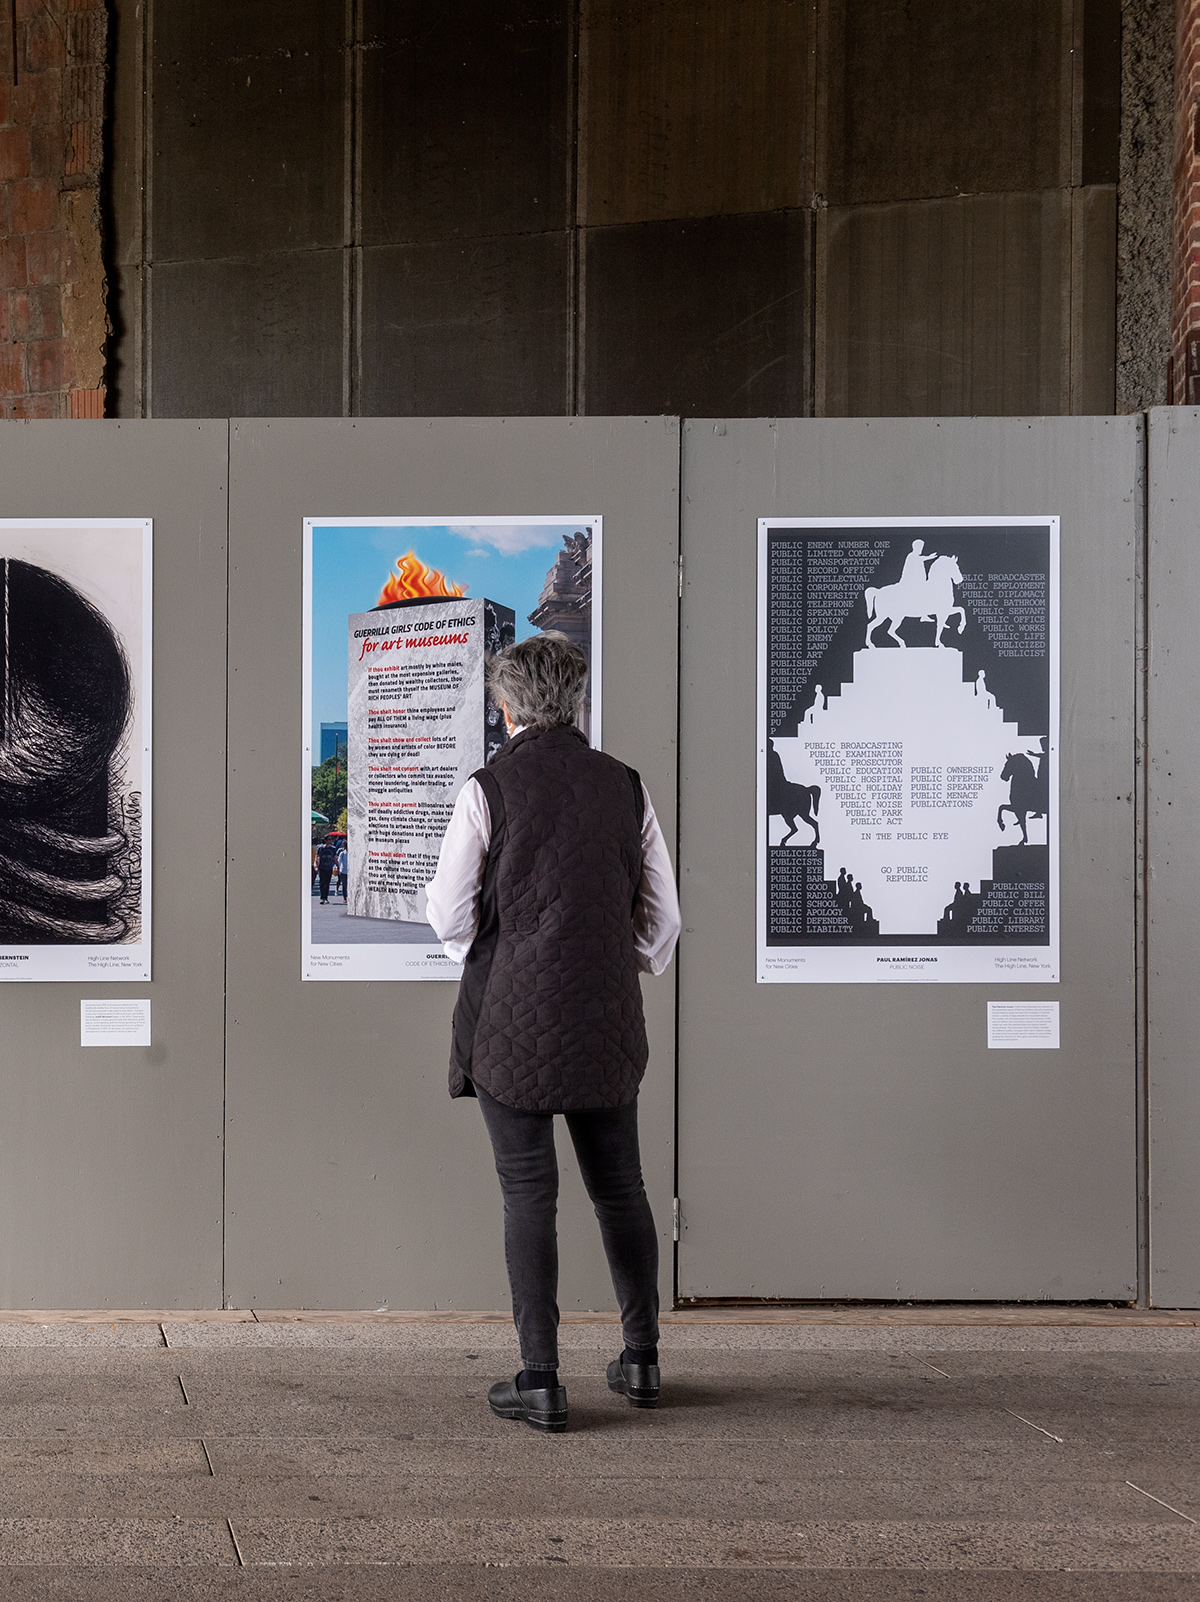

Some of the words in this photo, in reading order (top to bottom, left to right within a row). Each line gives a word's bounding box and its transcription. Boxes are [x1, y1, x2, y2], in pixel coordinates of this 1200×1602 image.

[354, 627, 389, 638] GUERRILLA
[414, 622, 434, 632] CODE
[436, 620, 446, 629] OF
[448, 617, 475, 628] ETHICS
[359, 638, 379, 661] for
[381, 637, 403, 651] art
[405, 632, 469, 648] museums
